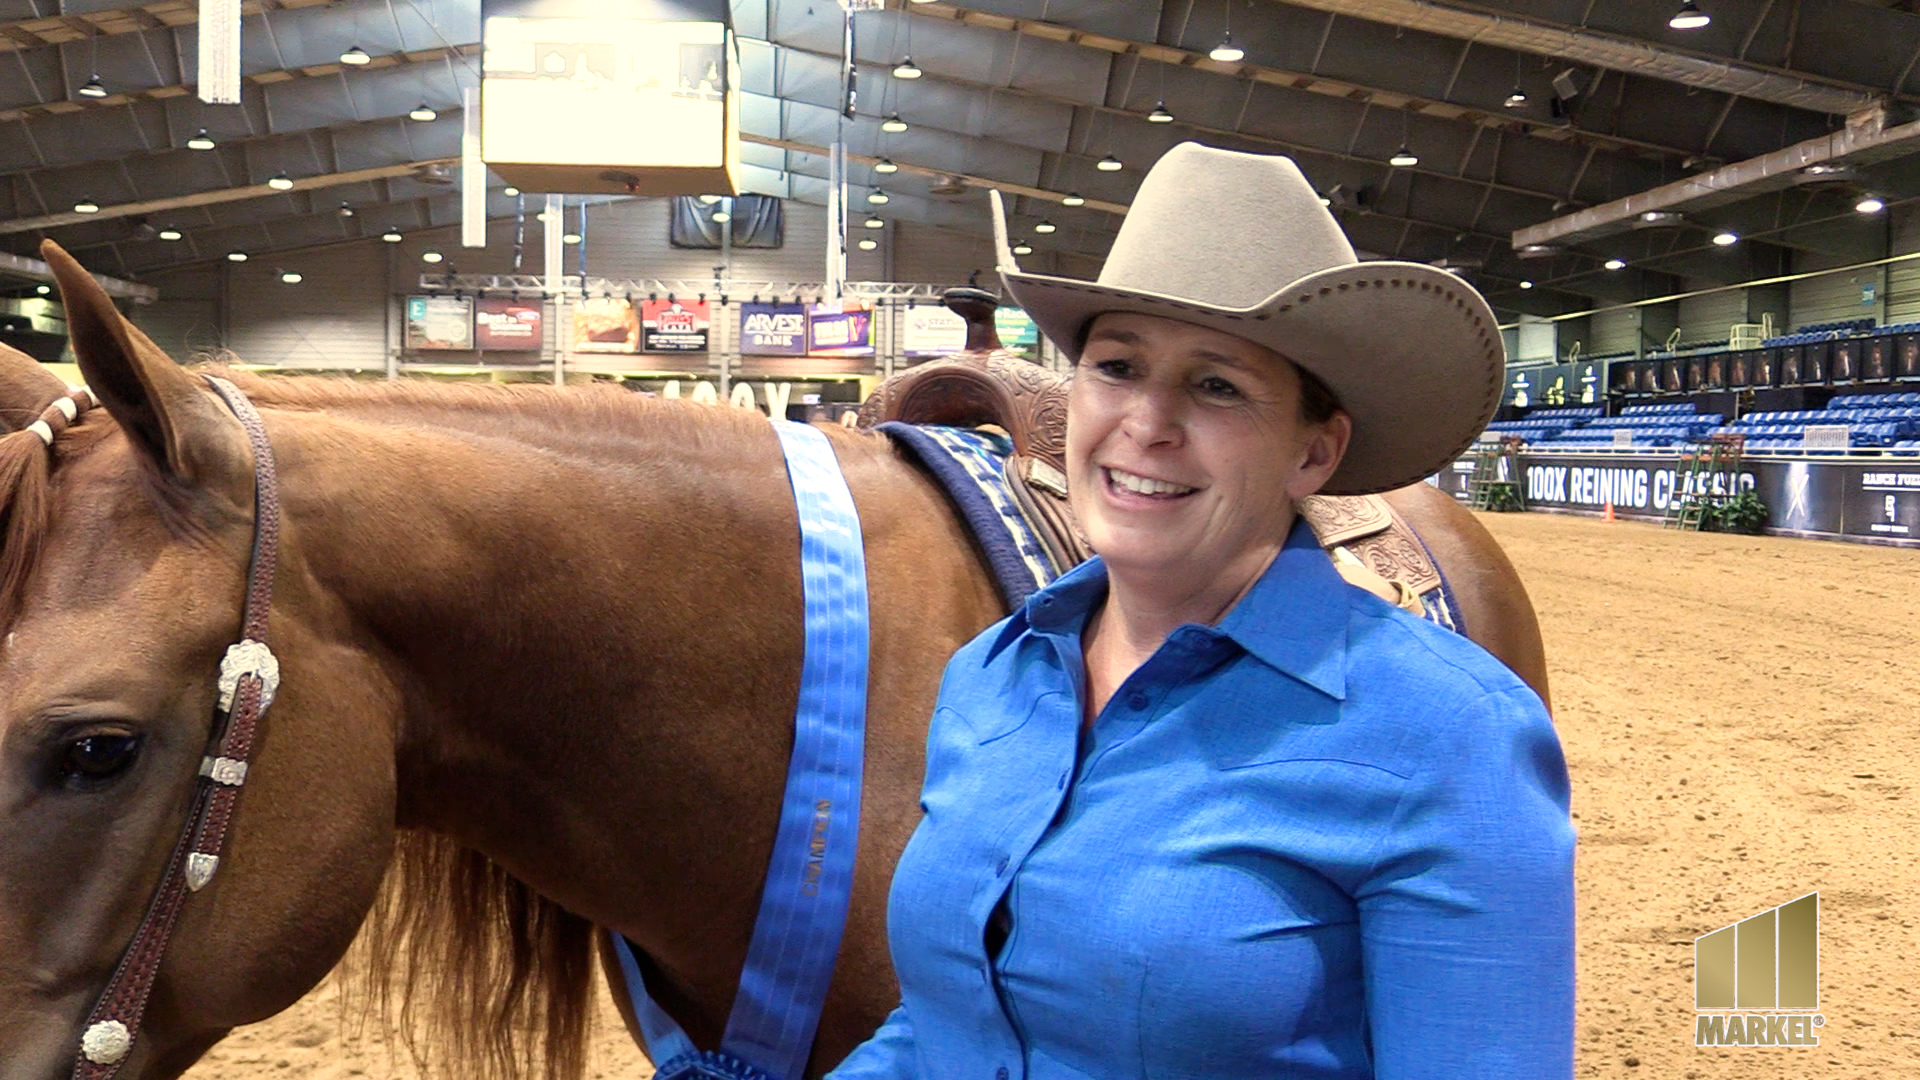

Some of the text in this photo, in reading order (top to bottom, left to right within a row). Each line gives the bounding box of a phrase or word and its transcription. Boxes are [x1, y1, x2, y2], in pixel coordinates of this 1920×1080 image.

[744, 314, 804, 332] ARVEST
[754, 335, 793, 346] BANK
[1527, 466, 1567, 502] 100X
[1570, 468, 1648, 507] REINING
